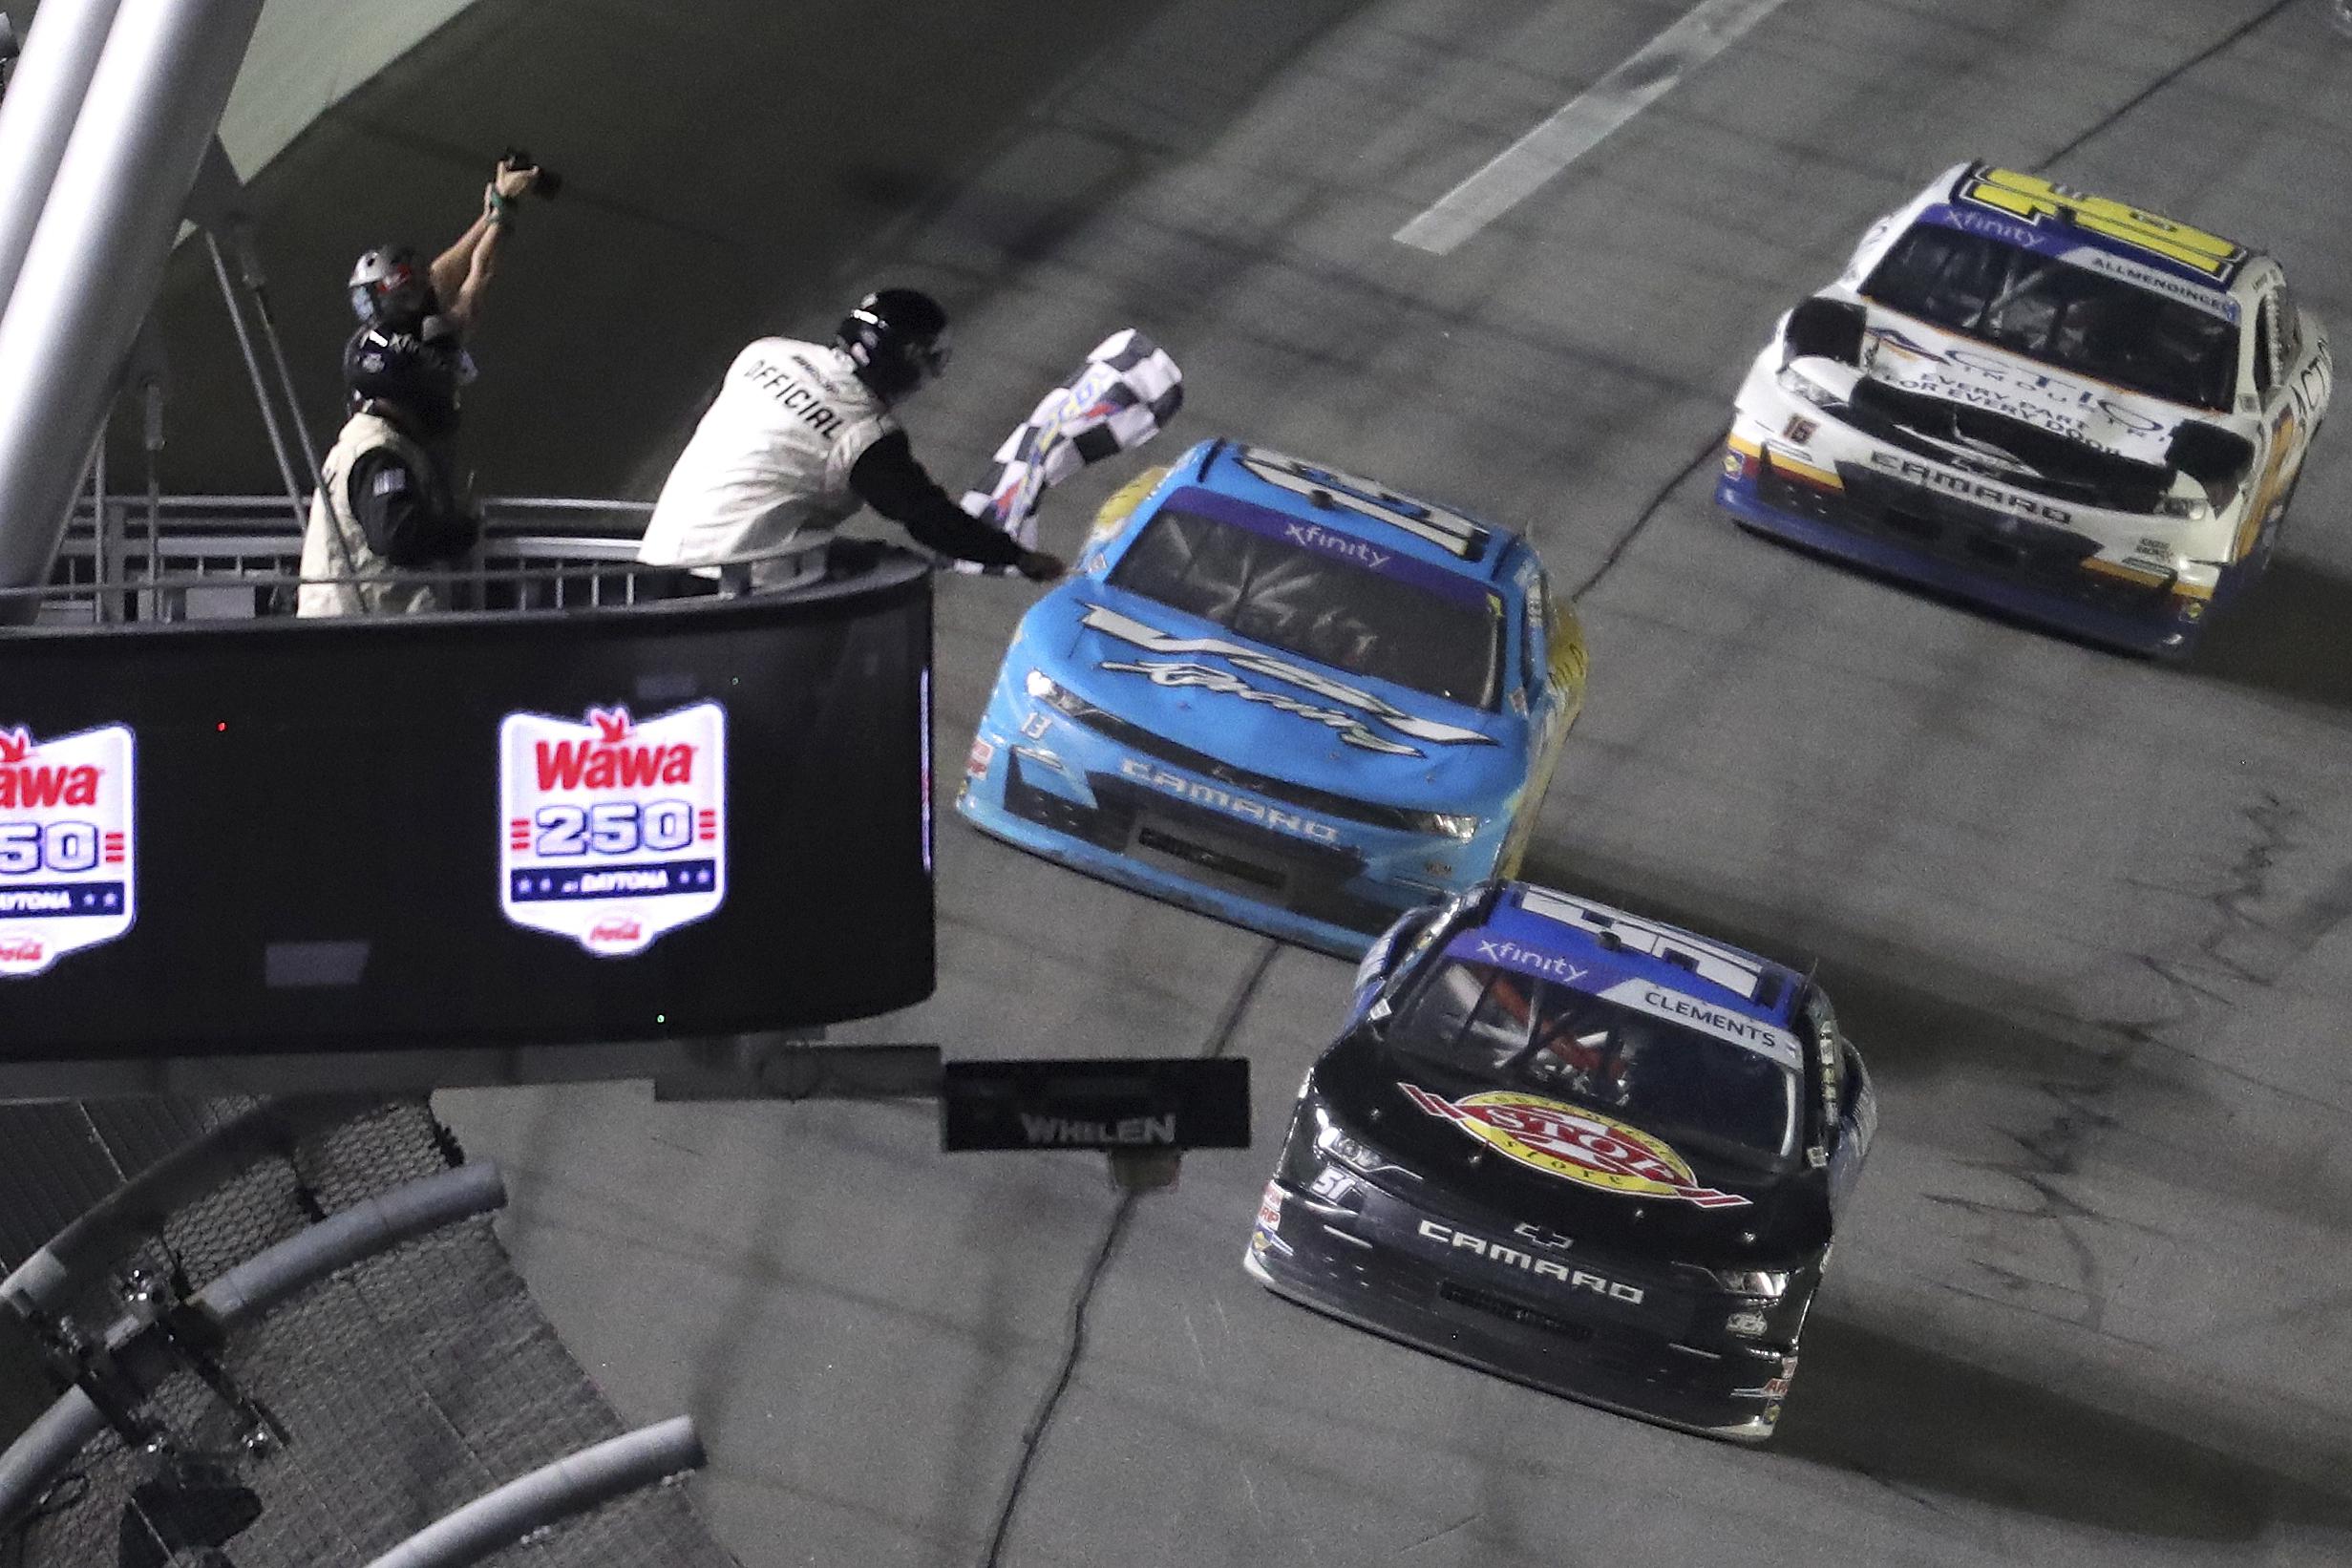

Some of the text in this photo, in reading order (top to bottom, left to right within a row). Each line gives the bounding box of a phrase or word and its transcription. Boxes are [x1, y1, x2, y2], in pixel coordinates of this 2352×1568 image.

[1945, 209, 2045, 248] xfinity
[744, 359, 843, 440] OFFICIAL
[1920, 372, 2089, 430] EVERY PART
[1947, 387, 2036, 420] EVERY
[1871, 450, 2072, 525] CAMARO
[1284, 522, 1391, 568] xfinity
[1019, 710, 1052, 740] 13
[0, 765, 98, 809] awa
[536, 740, 695, 792] Wawa
[1121, 758, 1339, 842] CAMARO
[0, 821, 98, 875] 50
[536, 798, 694, 857] 250
[1477, 940, 1588, 983] xfinity
[1643, 991, 1776, 1049] CLEMENTS
[1486, 1107, 1675, 1180] STOP
[1311, 1164, 1357, 1202] 51
[1418, 1218, 1644, 1305] CAMARO
